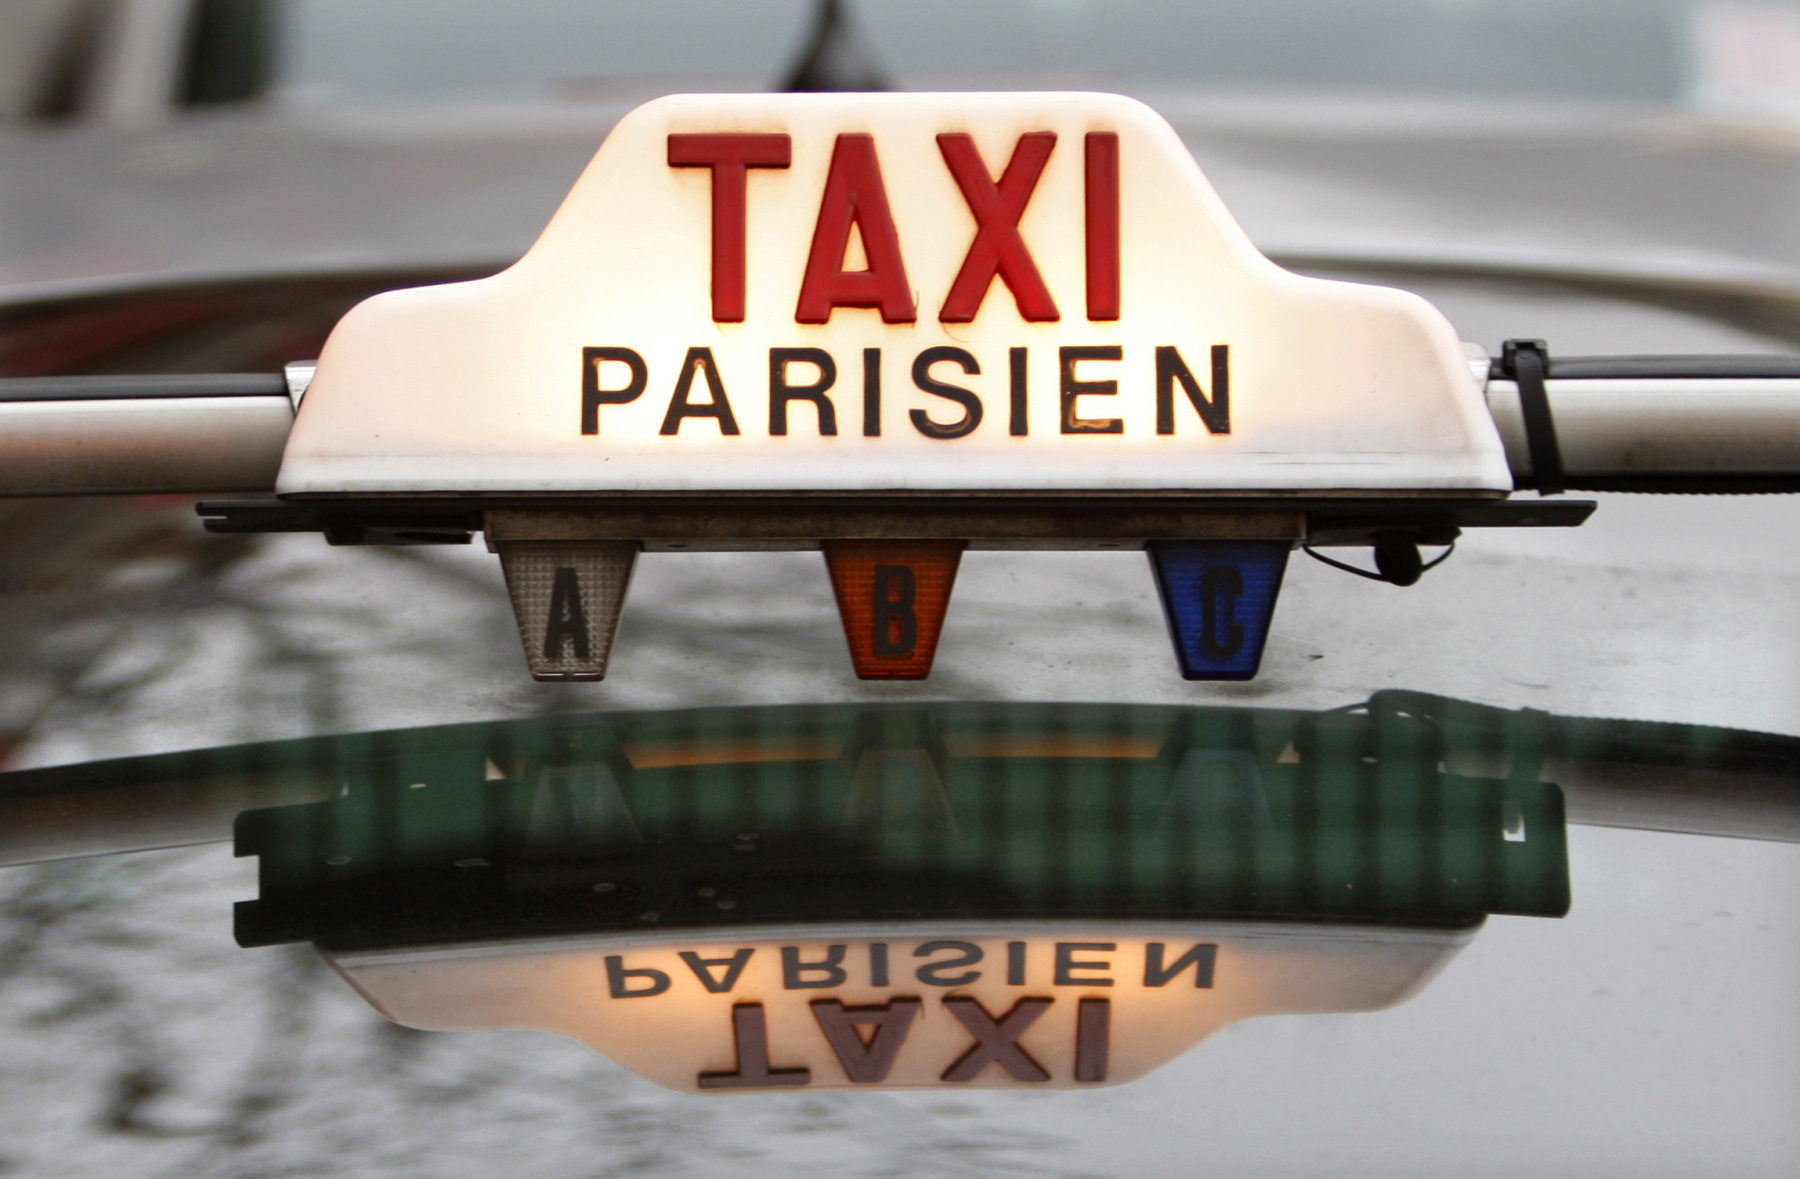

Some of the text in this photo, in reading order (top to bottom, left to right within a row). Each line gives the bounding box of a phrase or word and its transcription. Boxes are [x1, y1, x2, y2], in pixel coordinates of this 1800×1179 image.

[667, 132, 1121, 324] TAXI
[580, 344, 1231, 440] PARISIEN
[543, 567, 589, 659] A
[873, 564, 917, 657] B
[1200, 564, 1246, 659] C
